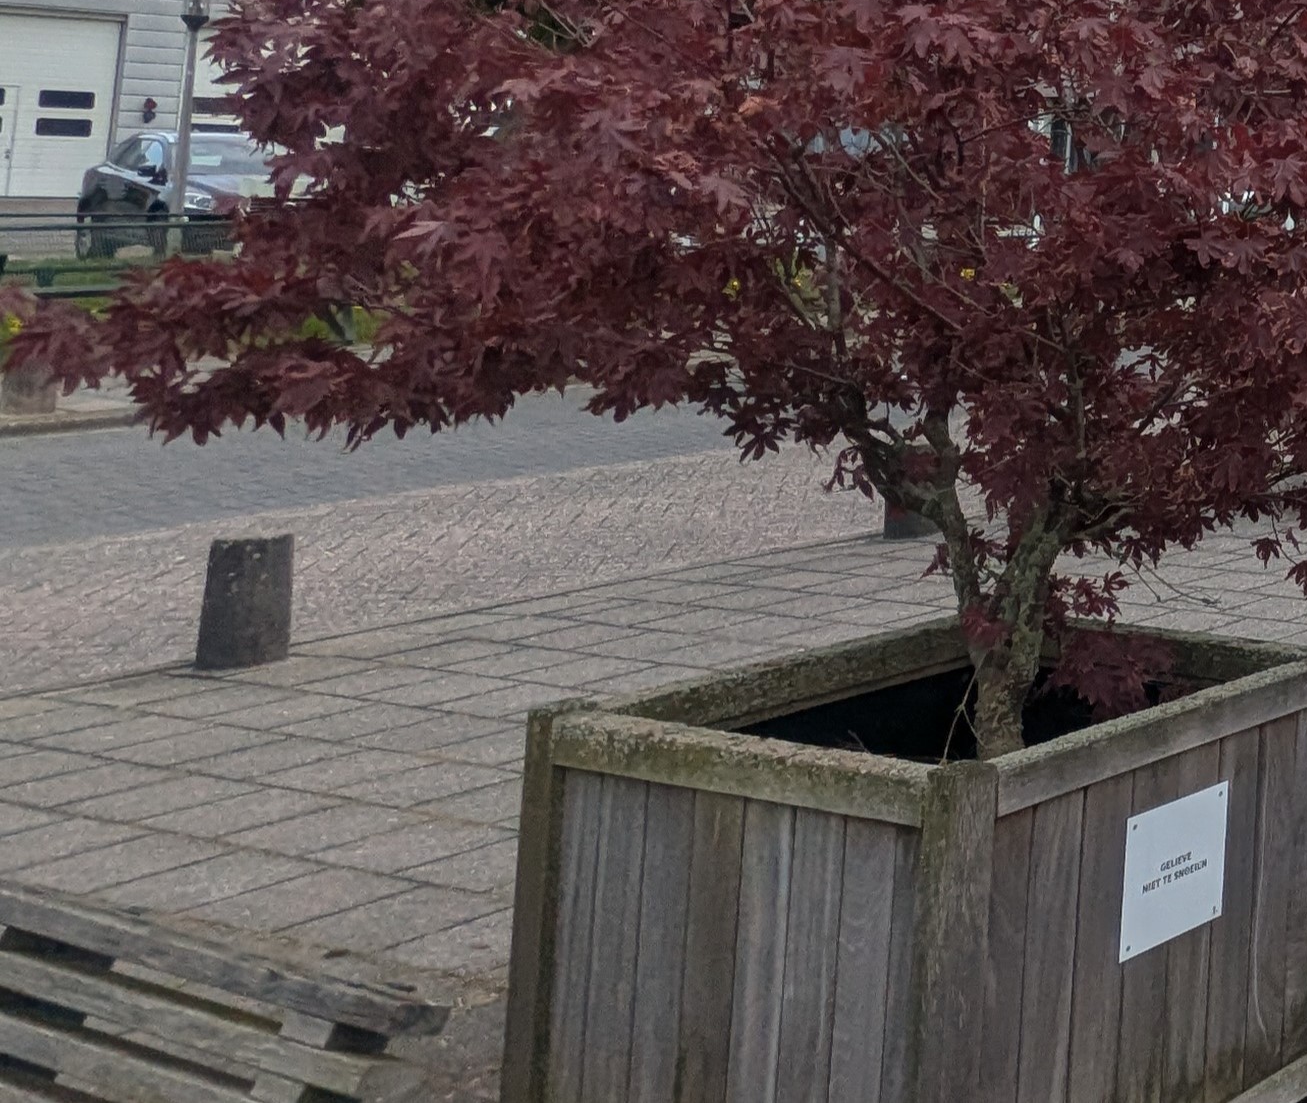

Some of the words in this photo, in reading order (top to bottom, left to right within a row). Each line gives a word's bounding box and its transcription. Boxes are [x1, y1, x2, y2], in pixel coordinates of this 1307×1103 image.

[1160, 851, 1193, 872] GELIEVE
[1142, 878, 1161, 894] NIET
[1163, 873, 1172, 885] TE
[1173, 858, 1208, 880] SNOEIEN
